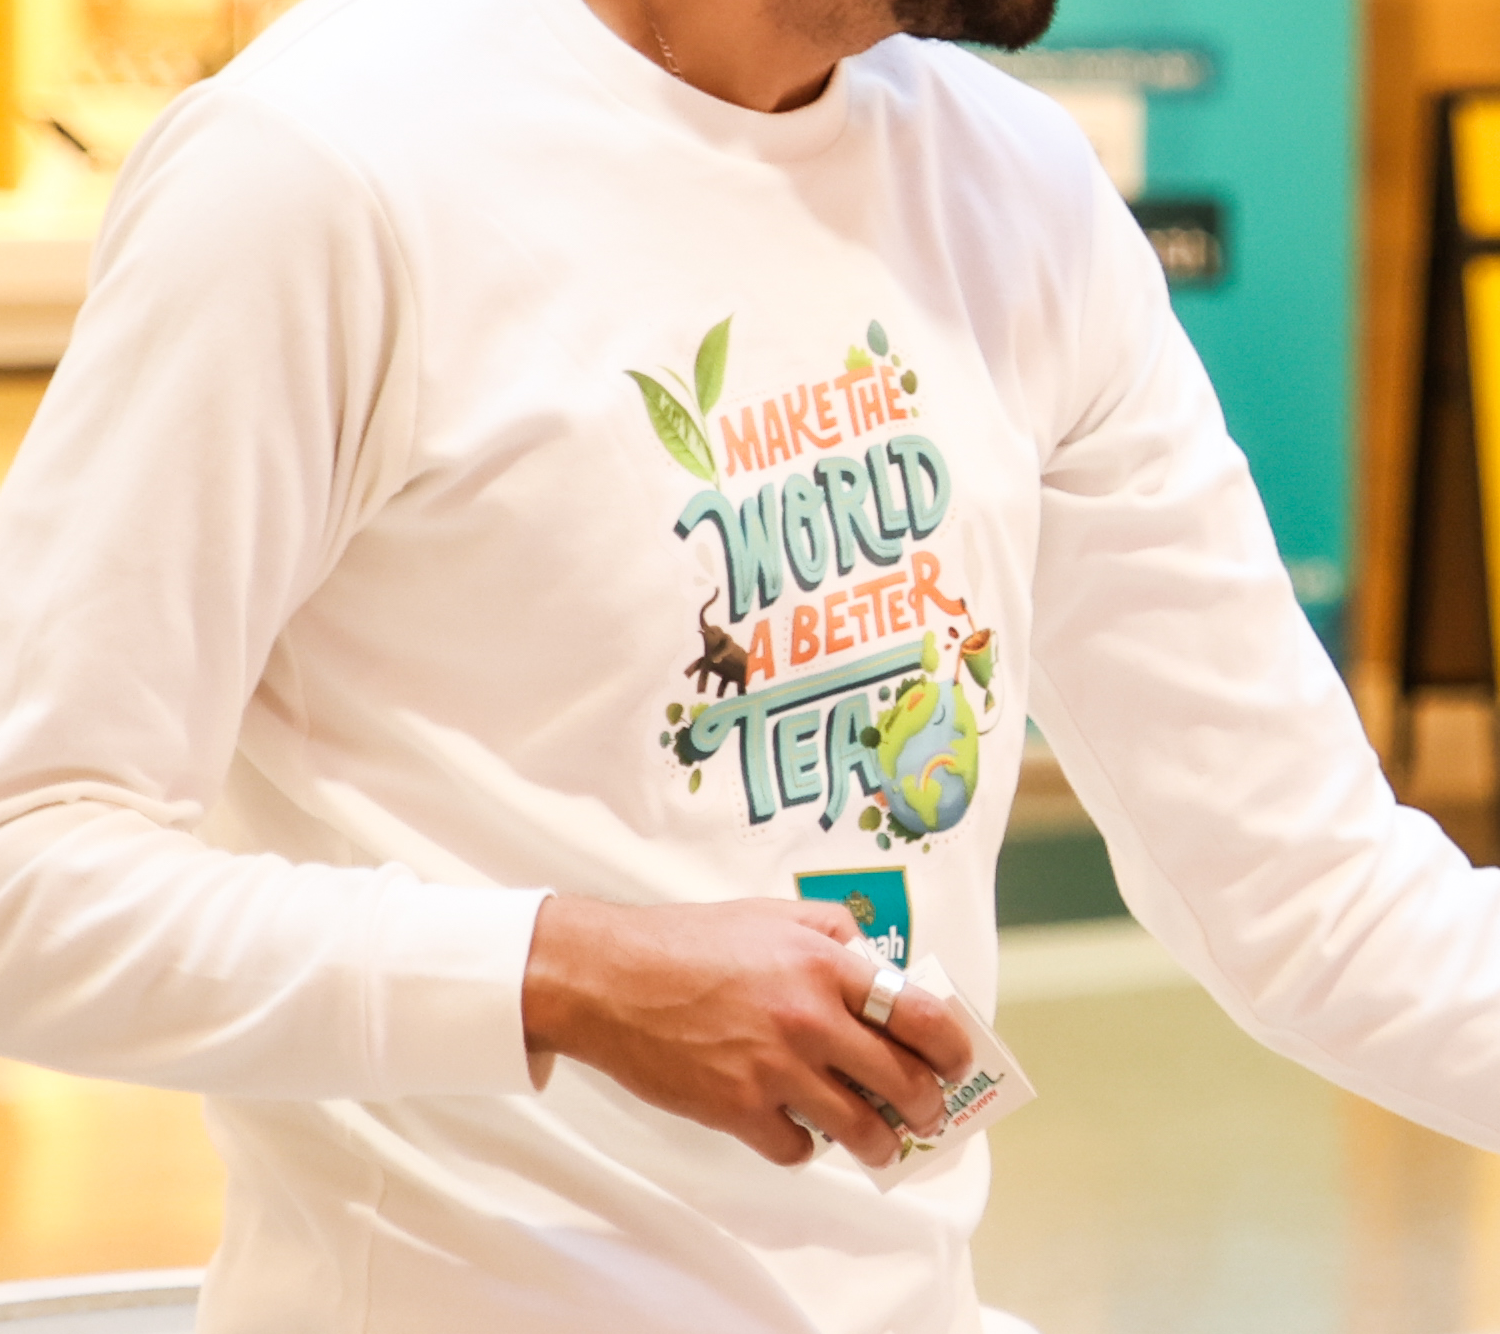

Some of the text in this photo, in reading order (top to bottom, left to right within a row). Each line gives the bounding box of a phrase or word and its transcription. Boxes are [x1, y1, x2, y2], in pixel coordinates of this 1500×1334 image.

[719, 384, 841, 479] MAKE
[835, 364, 903, 444] THE
[672, 434, 953, 625] WORLD
[745, 550, 966, 681] A BETTER
[690, 637, 932, 833] TEA
